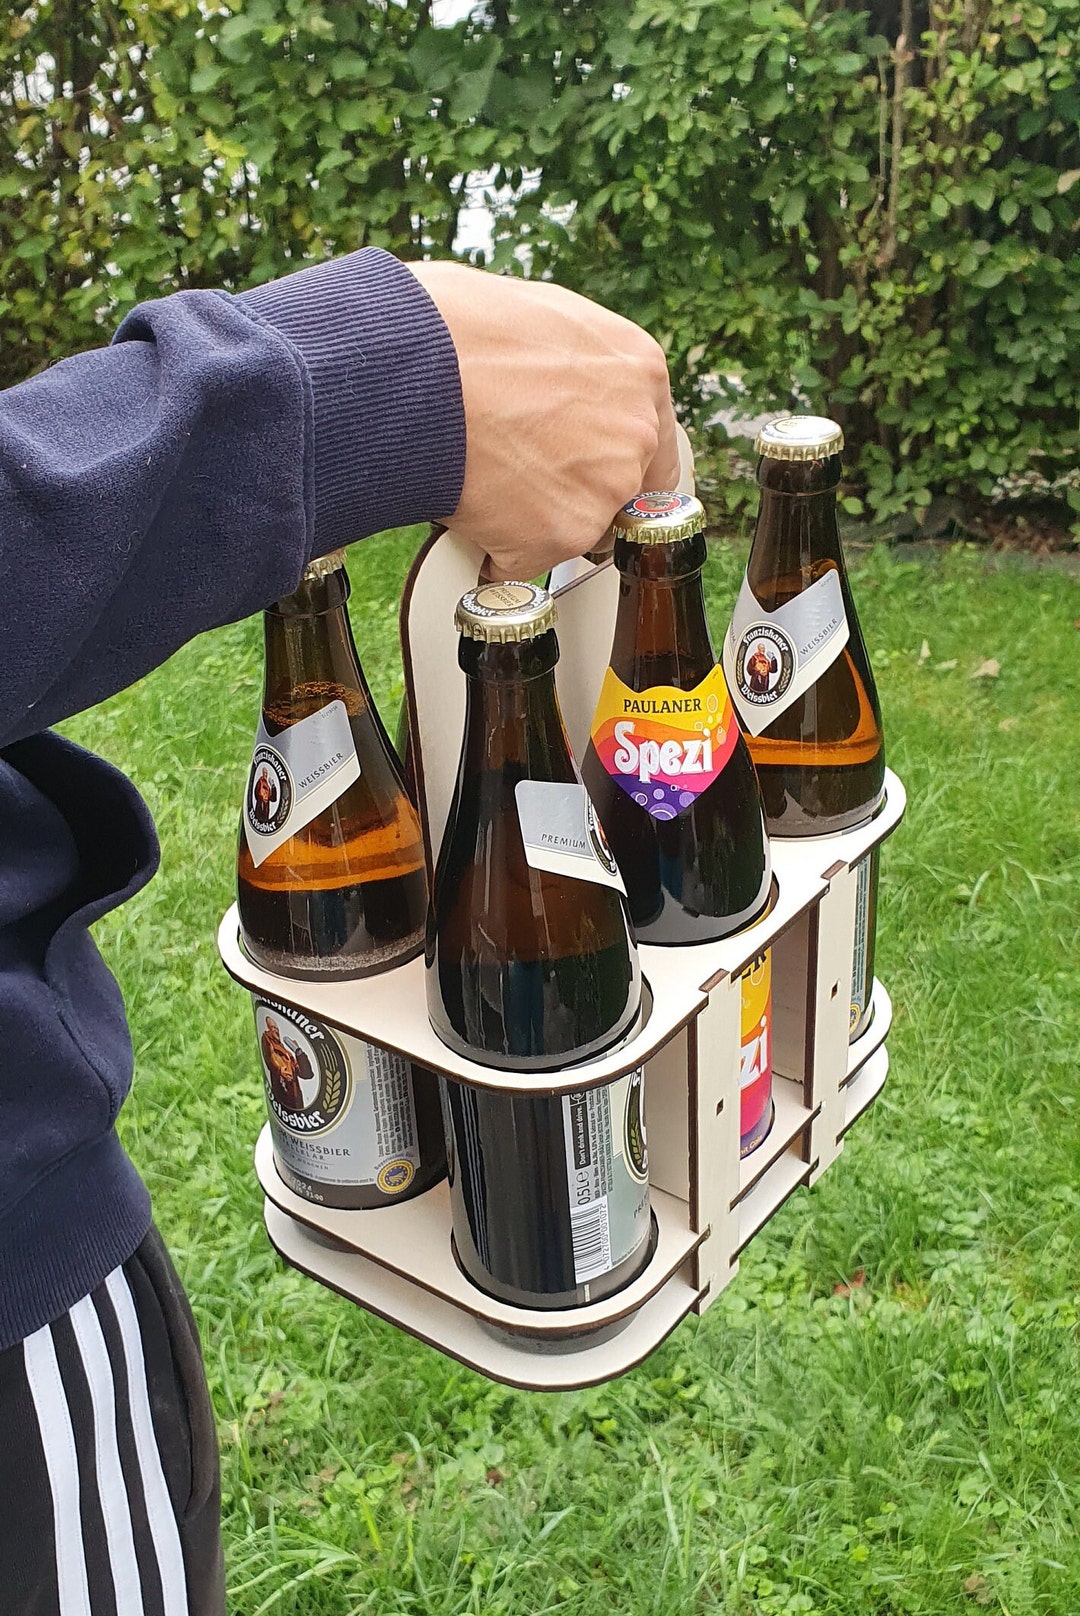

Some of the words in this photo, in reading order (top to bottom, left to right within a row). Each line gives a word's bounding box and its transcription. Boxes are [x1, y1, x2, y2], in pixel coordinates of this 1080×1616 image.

[742, 626, 789, 653] Franziskaner
[799, 617, 838, 656] WEISSBIER
[740, 683, 779, 703] Weissbier
[623, 698, 702, 714] PAULANER
[614, 720, 714, 784] Spezi
[298, 752, 343, 789] WEISSBIER
[541, 833, 587, 849] PREMIUM
[576, 1122, 584, 1134] and
[576, 1134, 586, 1149] drink
[578, 1148, 587, 1165] Don't
